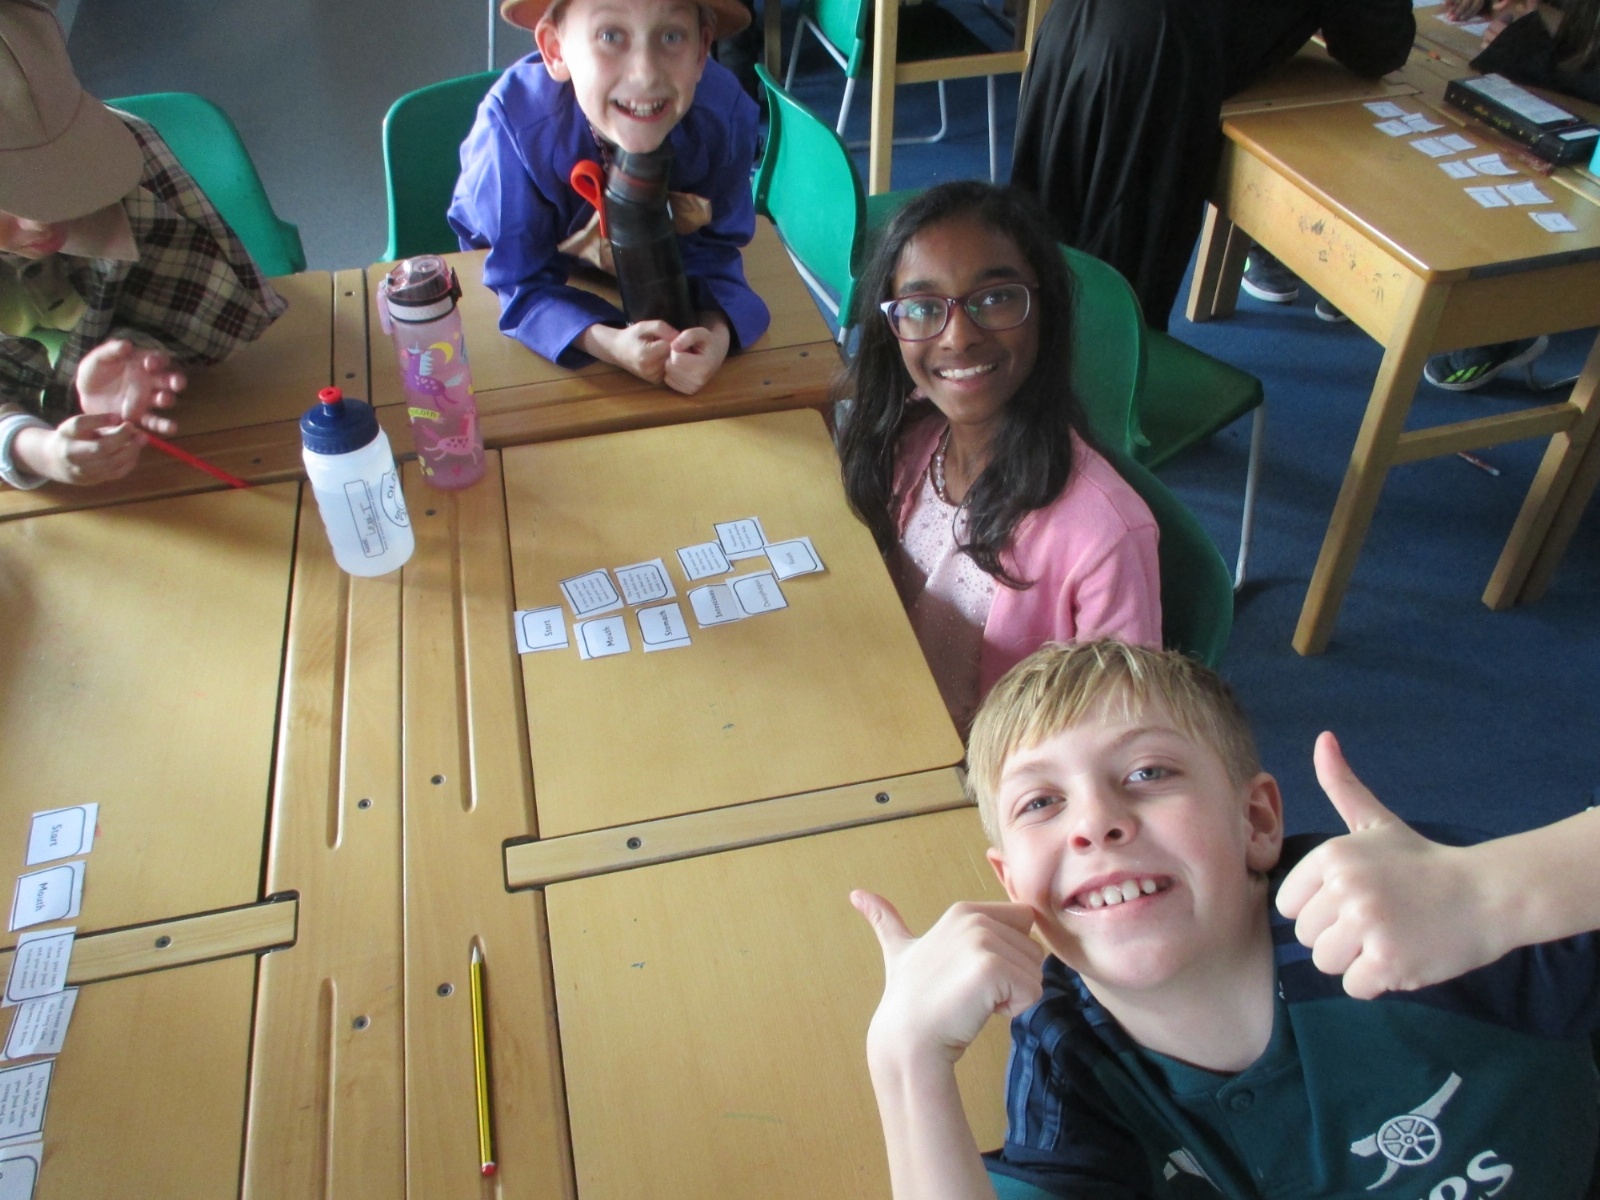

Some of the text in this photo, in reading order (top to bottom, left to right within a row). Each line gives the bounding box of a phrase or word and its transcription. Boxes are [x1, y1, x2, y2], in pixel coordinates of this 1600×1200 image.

[544, 619, 552, 637] Start
[664, 610, 673, 637] Stomach
[606, 625, 615, 647] Mouth
[50, 824, 62, 847] Start
[36, 882, 48, 912] Mouth
